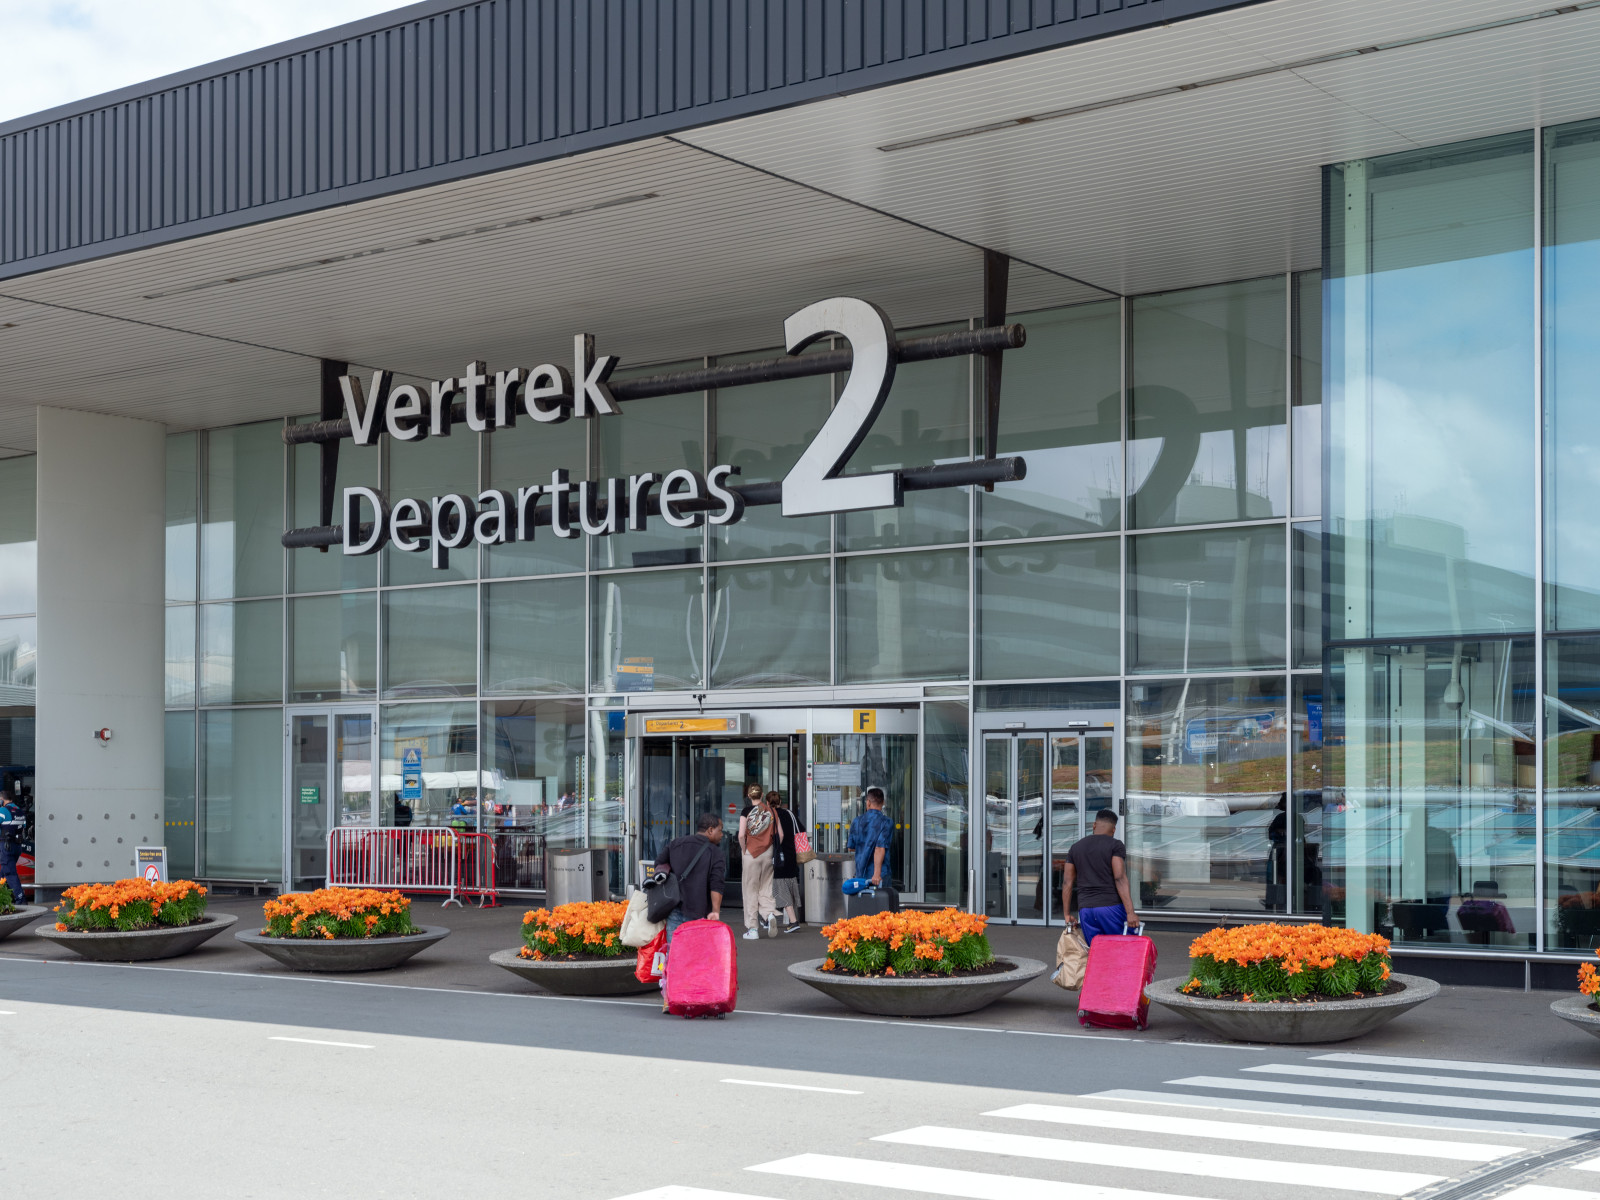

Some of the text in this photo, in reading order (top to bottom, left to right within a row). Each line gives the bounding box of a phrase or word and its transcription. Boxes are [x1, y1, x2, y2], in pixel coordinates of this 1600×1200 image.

[339, 333, 621, 446] Vertrek
[782, 296, 903, 517] 2
[343, 464, 742, 569] Departures
[859, 712, 870, 730] F
